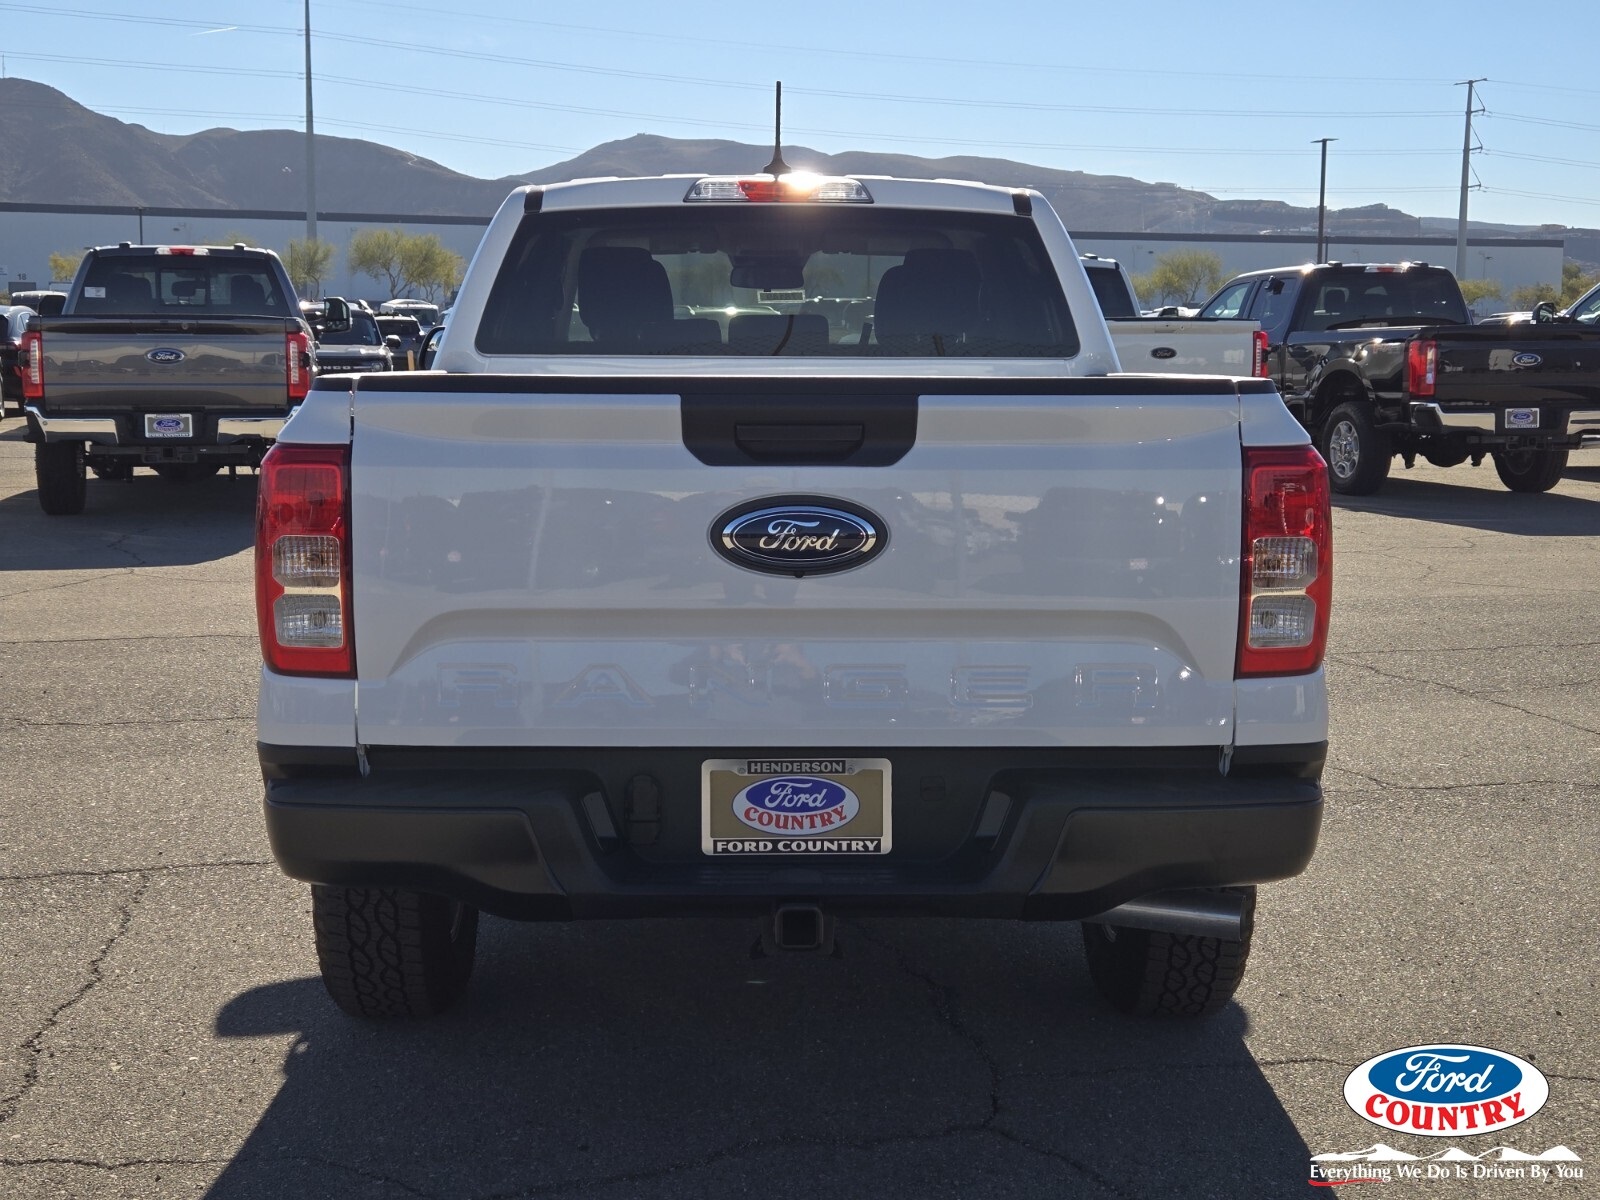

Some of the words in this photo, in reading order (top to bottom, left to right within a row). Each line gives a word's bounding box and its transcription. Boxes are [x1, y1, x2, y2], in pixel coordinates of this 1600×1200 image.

[759, 519, 841, 552] Ford
[436, 663, 1161, 709] RANGER
[750, 761, 843, 773] HENDERSON
[764, 781, 827, 807] Ford
[744, 805, 847, 829] COUNTRY
[716, 840, 773, 852] FORD
[777, 840, 879, 852] COUNTRY
